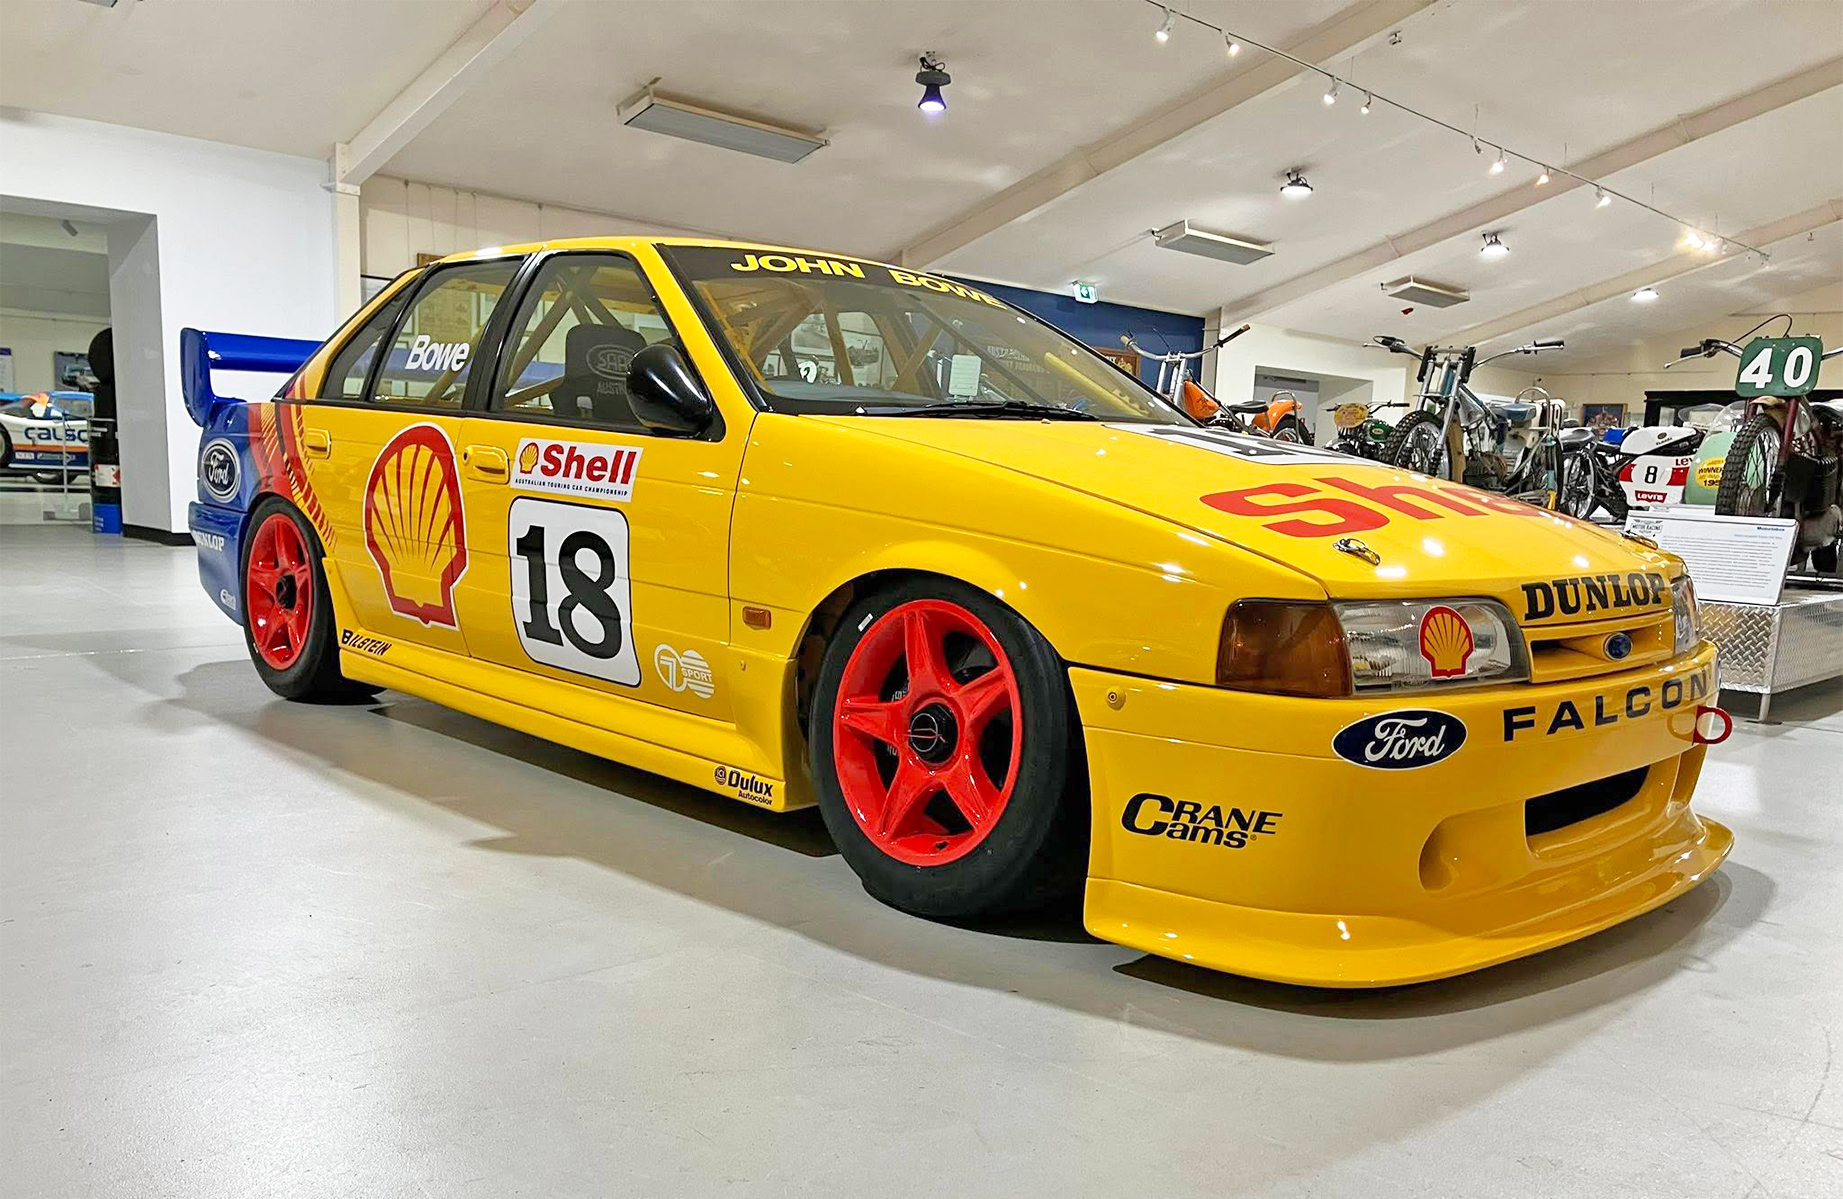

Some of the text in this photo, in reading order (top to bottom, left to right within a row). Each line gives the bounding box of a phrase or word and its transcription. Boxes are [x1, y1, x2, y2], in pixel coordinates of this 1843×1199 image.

[731, 254, 1008, 310] JOHN BOWE
[405, 335, 470, 371] Bowe
[208, 451, 230, 485] Ford
[541, 444, 637, 484] Shell
[1644, 465, 1658, 484] 8
[515, 478, 546, 487] AUSTRALIAN
[547, 482, 570, 490] TOURING
[584, 485, 629, 496] CHAMPIONSHIP
[516, 525, 623, 659] 18
[1522, 573, 1667, 621] DUNLOP
[341, 628, 393, 656] BILSTEIN
[681, 667, 713, 683] SPORT
[1503, 667, 1707, 742] FALCON
[1364, 717, 1446, 763] Ford
[728, 769, 774, 798] Dulux
[1121, 792, 1283, 837] CRANE
